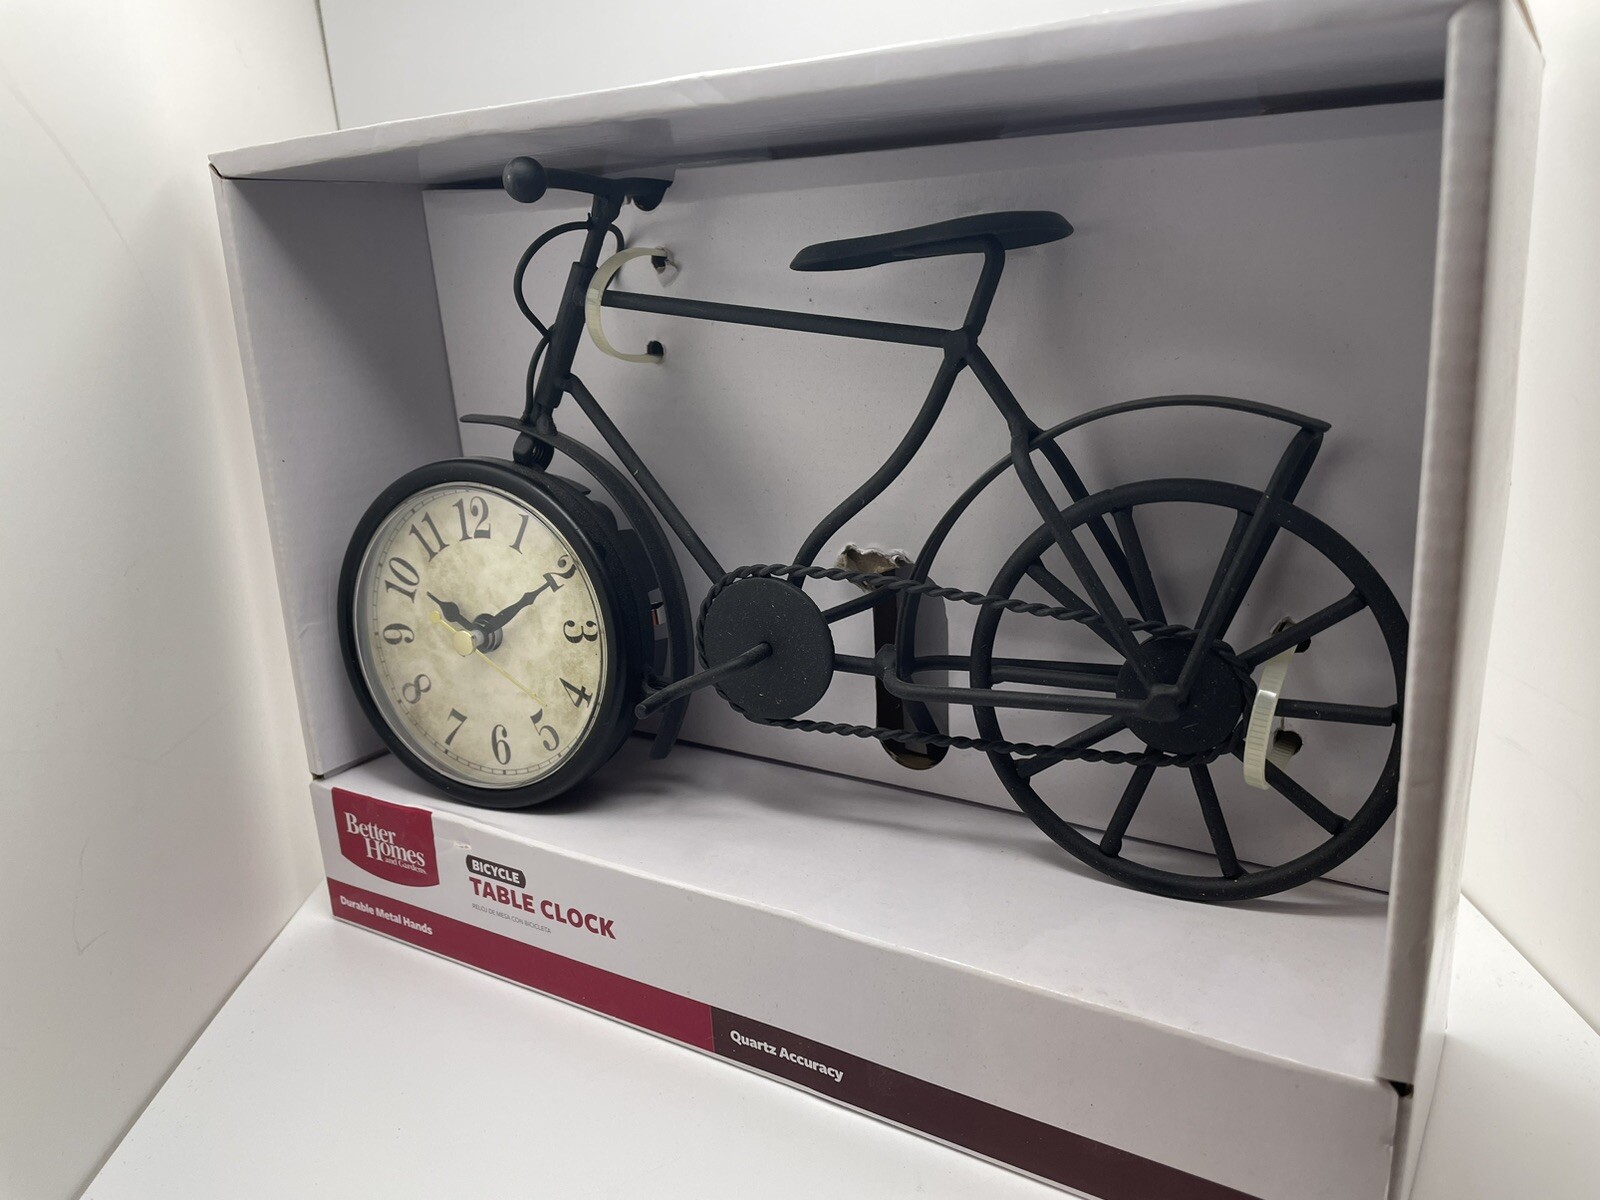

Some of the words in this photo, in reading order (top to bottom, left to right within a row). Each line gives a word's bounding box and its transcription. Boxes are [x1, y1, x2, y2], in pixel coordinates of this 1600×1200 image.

[409, 511, 450, 562] 11
[452, 496, 492, 542] 12
[509, 513, 529, 556] 1
[385, 556, 420, 603] 10
[542, 554, 577, 593] 2
[383, 623, 415, 645] 9
[563, 620, 598, 644] 3
[402, 673, 432, 705] 8
[559, 678, 593, 708] 4
[445, 708, 468, 746] 7
[491, 724, 511, 765] 6
[530, 708, 560, 751] 5
[344, 811, 396, 845] Better
[364, 838, 426, 867] Homes
[385, 858, 397, 867] and
[398, 860, 427, 875] Gardens
[471, 859, 521, 884] BICYCLE
[340, 895, 374, 915] Durable
[375, 907, 402, 924] Metal
[402, 916, 433, 935] Hands
[468, 876, 535, 914] TABLE
[540, 899, 617, 940] CLOCK
[472, 903, 488, 913] RELOJ
[488, 908, 496, 916] DE
[730, 1030, 776, 1056] Quartz
[779, 1047, 844, 1082] Accuracy
